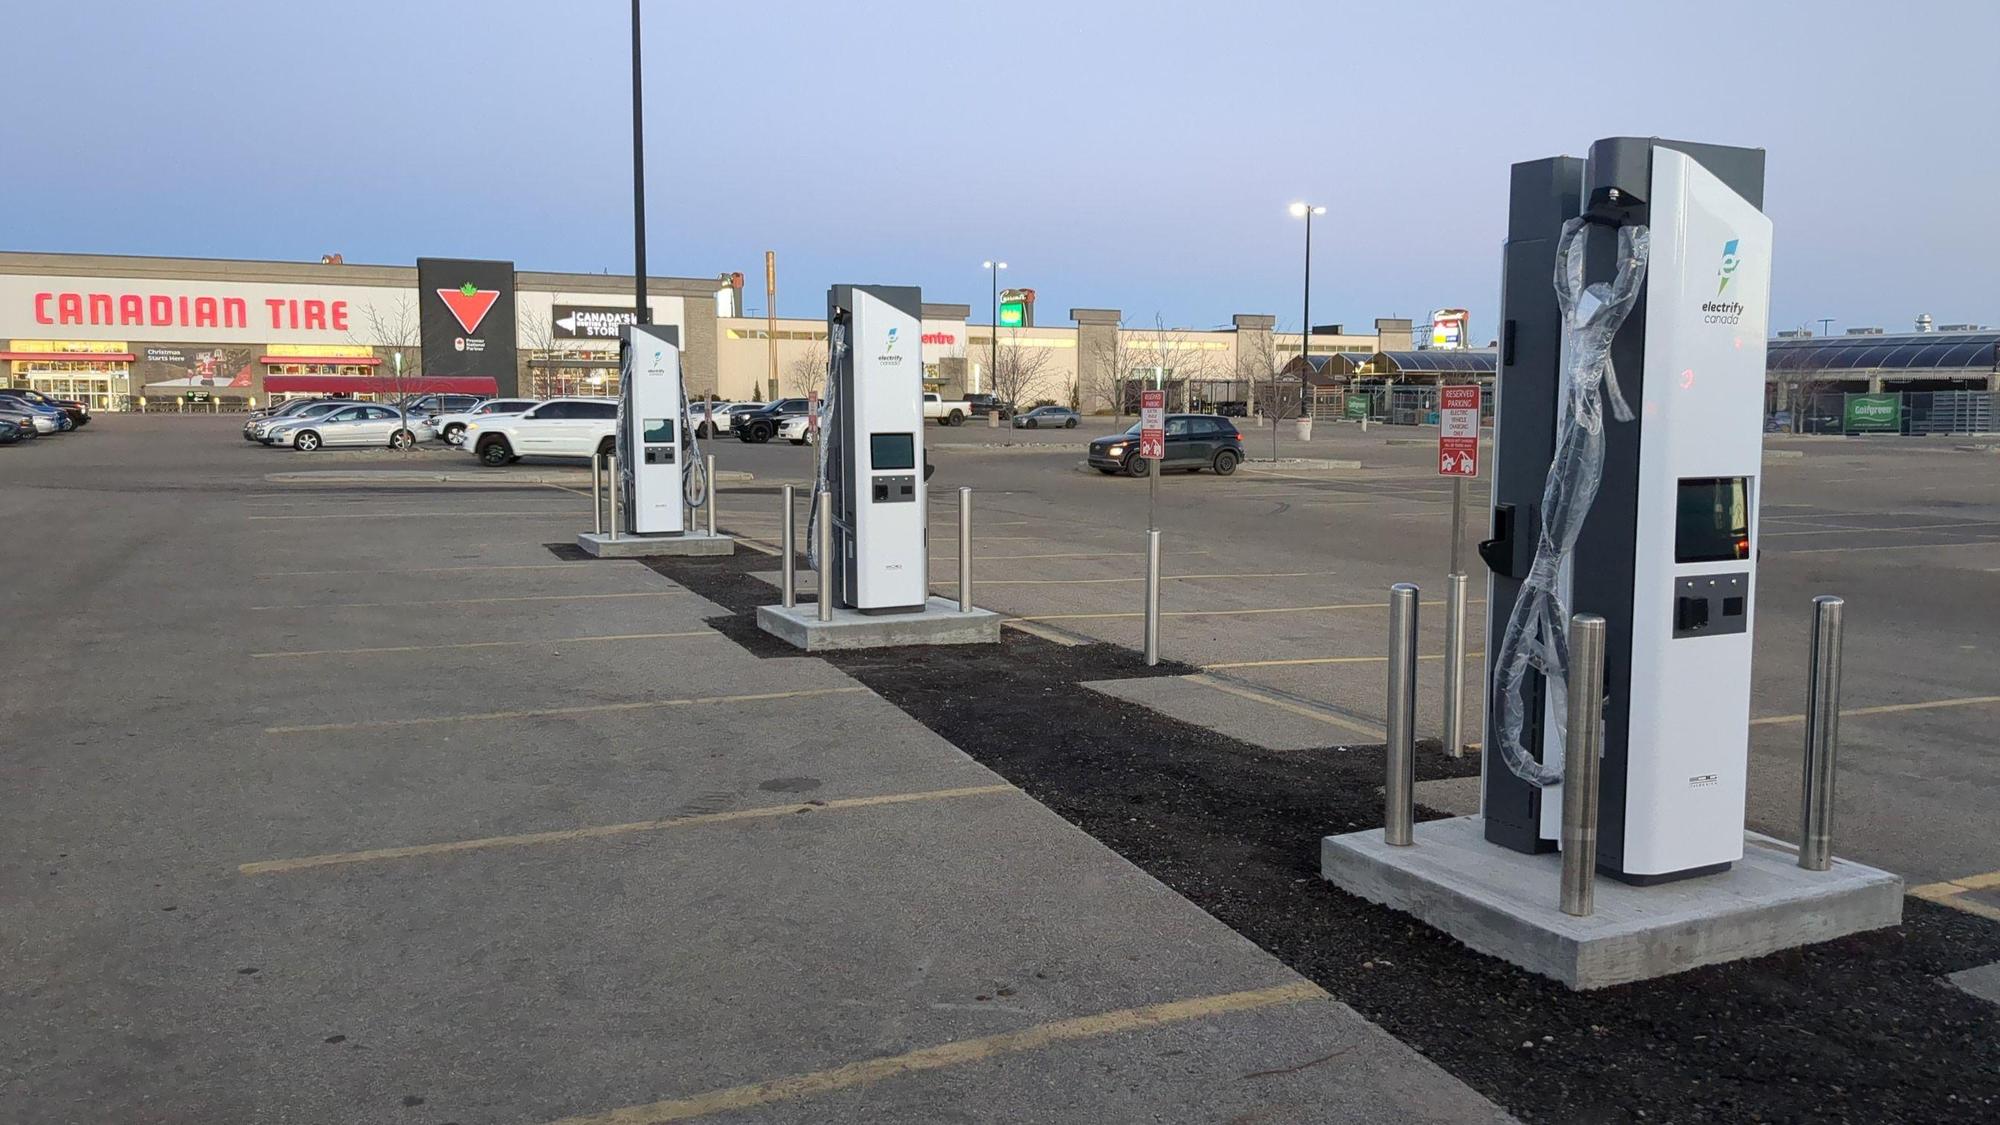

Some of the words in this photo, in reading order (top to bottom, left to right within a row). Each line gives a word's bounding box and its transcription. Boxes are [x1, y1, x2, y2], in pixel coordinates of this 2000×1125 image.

[34, 292, 247, 328] CANADIAN
[265, 299, 349, 331] TIRE
[1702, 300, 1744, 316] electrify
[576, 312, 630, 323] CANADA'S
[1704, 314, 1739, 325] canada
[921, 332, 955, 344] entre
[1446, 389, 1475, 398] RESERVED
[1447, 399, 1472, 408] PARKING
